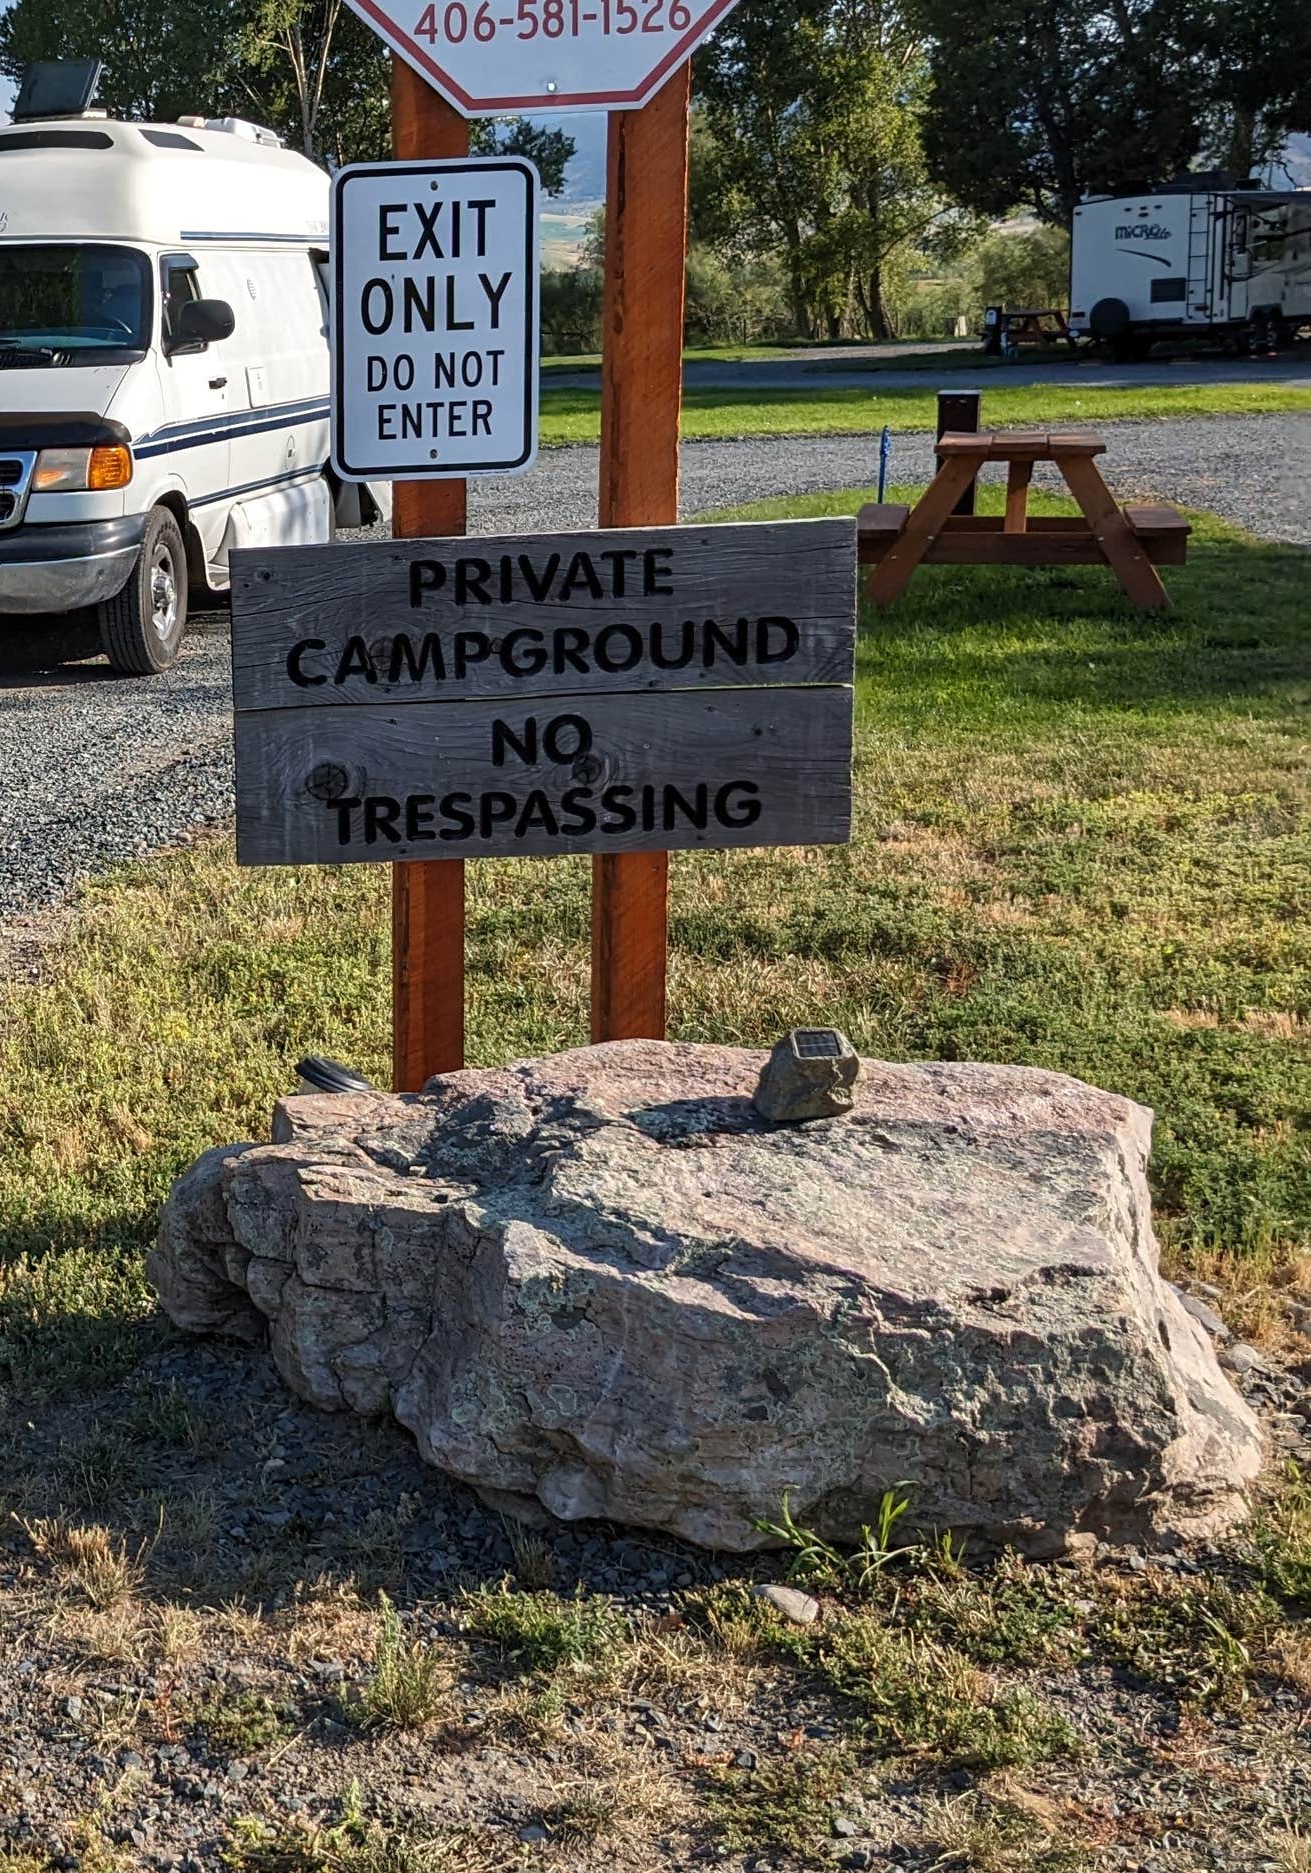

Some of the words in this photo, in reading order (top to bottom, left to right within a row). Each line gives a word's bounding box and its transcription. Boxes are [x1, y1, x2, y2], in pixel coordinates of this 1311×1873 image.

[413, 0, 691, 44] 406-581-1526
[378, 198, 497, 262] EXIT
[360, 271, 513, 336] ONLY
[367, 353, 415, 393] DO
[434, 349, 505, 390] NOT
[377, 399, 493, 441] ENTER
[409, 547, 675, 608] PRIVATE
[286, 615, 801, 688] CAMPGROUND
[491, 714, 593, 767] NO
[325, 780, 762, 846] TRESPASSING
